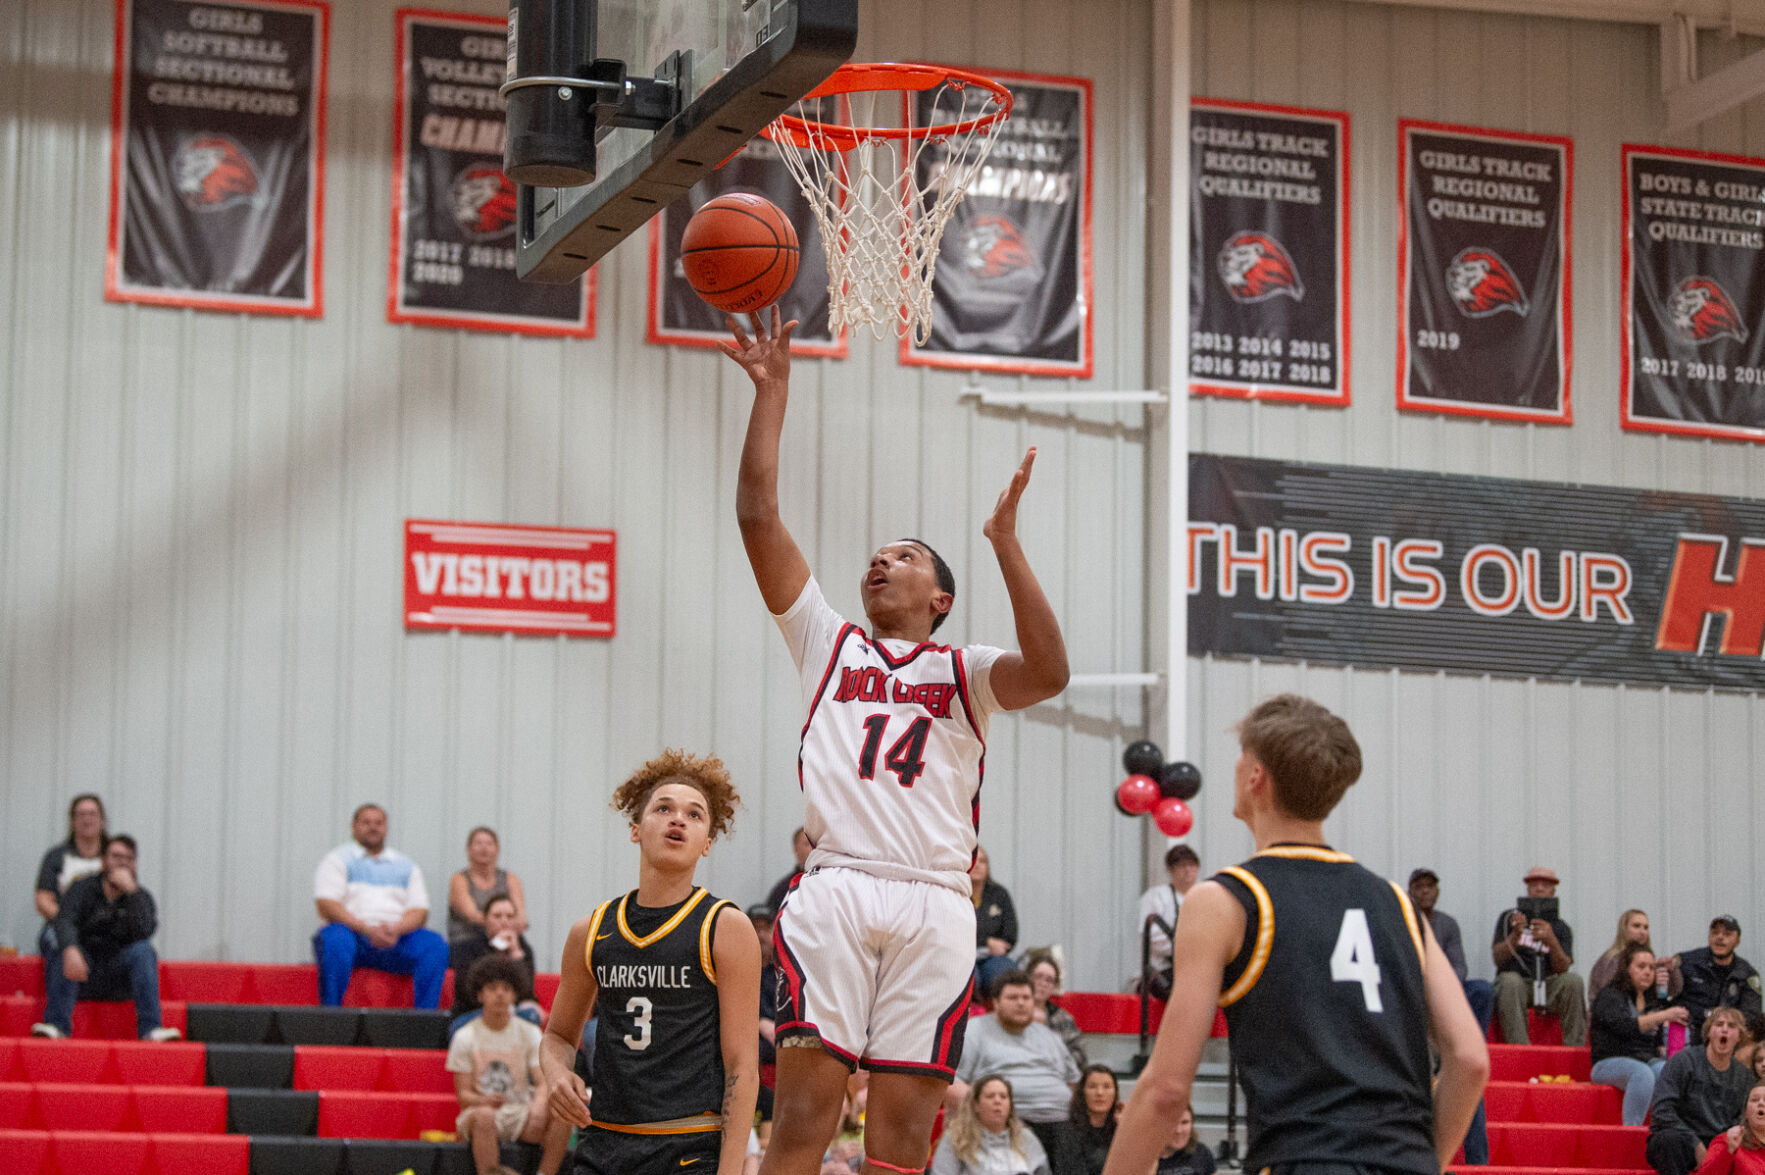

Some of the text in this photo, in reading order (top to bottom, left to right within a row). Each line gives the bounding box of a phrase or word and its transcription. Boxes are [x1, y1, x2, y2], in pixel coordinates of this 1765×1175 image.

[188, 7, 264, 34] GIRLS
[163, 30, 288, 63] SOFTBALL
[154, 55, 296, 90] SECTIONAL
[148, 82, 299, 117] CHAMPIONS
[1191, 126, 1329, 157] GIRLS TRACK
[1205, 151, 1316, 180] REGIONAL
[1420, 150, 1551, 182] GIRLS TRACK
[1200, 175, 1321, 204] QUALIFIERS
[1432, 175, 1540, 204] REGIONAL
[1639, 173, 1692, 195] BOYS
[1695, 179, 1711, 198] &
[1427, 197, 1546, 229] QUALIFIERS
[1641, 196, 1702, 219] STATE
[1648, 221, 1764, 250] QUALIFIERS
[1191, 331, 1331, 361] 2013 2014 2015
[1417, 329, 1460, 351] 2019
[1191, 354, 1331, 384] 2016 2017 2018
[1641, 357, 1765, 386] 2017 2018 201
[411, 552, 610, 603] VISITORS
[1188, 522, 1355, 604] THIS
[1372, 536, 1447, 611] IS
[1460, 543, 1635, 625] OUR
[858, 713, 933, 788] 14
[1330, 908, 1384, 1013] 4
[597, 965, 691, 988] CLARKSVILLE
[623, 996, 653, 1050] 3
